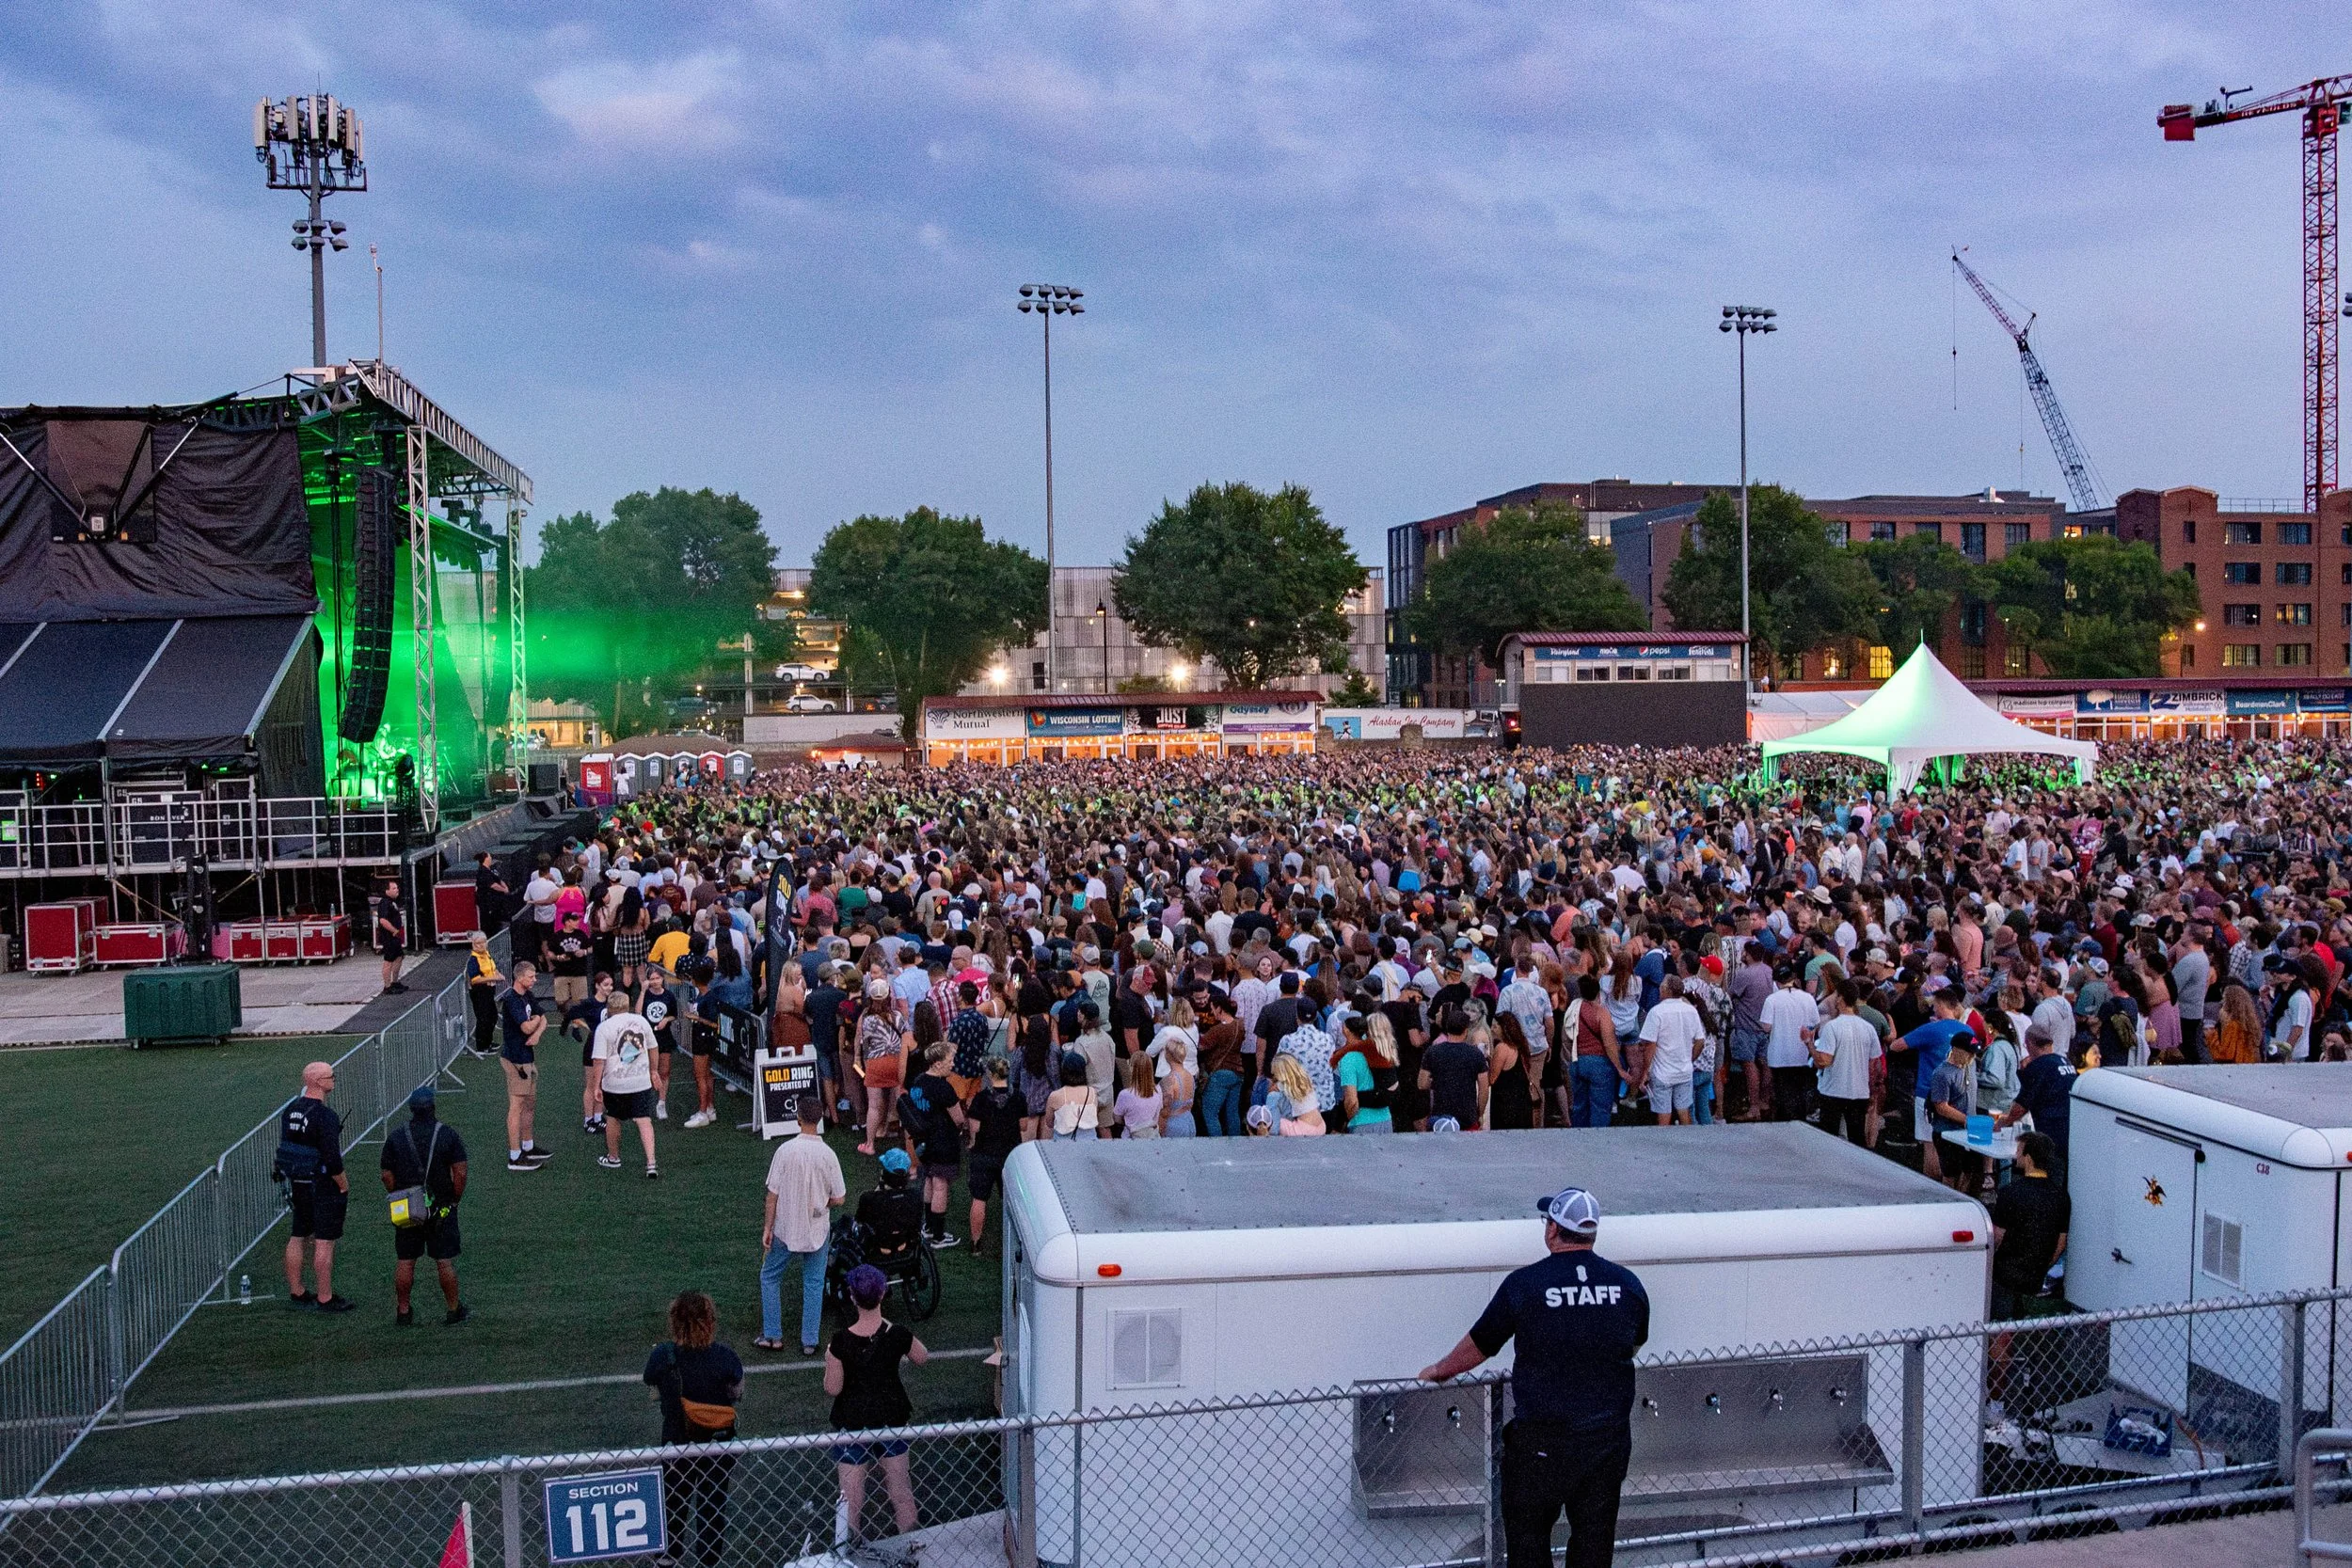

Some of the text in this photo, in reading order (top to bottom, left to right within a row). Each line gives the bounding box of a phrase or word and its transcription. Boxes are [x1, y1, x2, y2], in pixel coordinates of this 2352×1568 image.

[1649, 646, 1671, 656] pepsi
[2172, 692, 2223, 702] ZIMBRICK
[953, 707, 1023, 719] Northwestern
[1050, 715, 1120, 724] WISCONSIN LOTTERY
[1156, 707, 1187, 724] JUST
[953, 720, 990, 729] Mutual
[1368, 715, 1402, 727] Alaskan
[1420, 715, 1456, 728] Company
[765, 1066, 814, 1083] GOLD RING
[2058, 1065, 2076, 1075] STA
[770, 1079, 811, 1092] PRESENTED BY
[1545, 1285, 1621, 1307] STAFF
[568, 1481, 639, 1499] SECTION
[565, 1498, 648, 1553] 112
